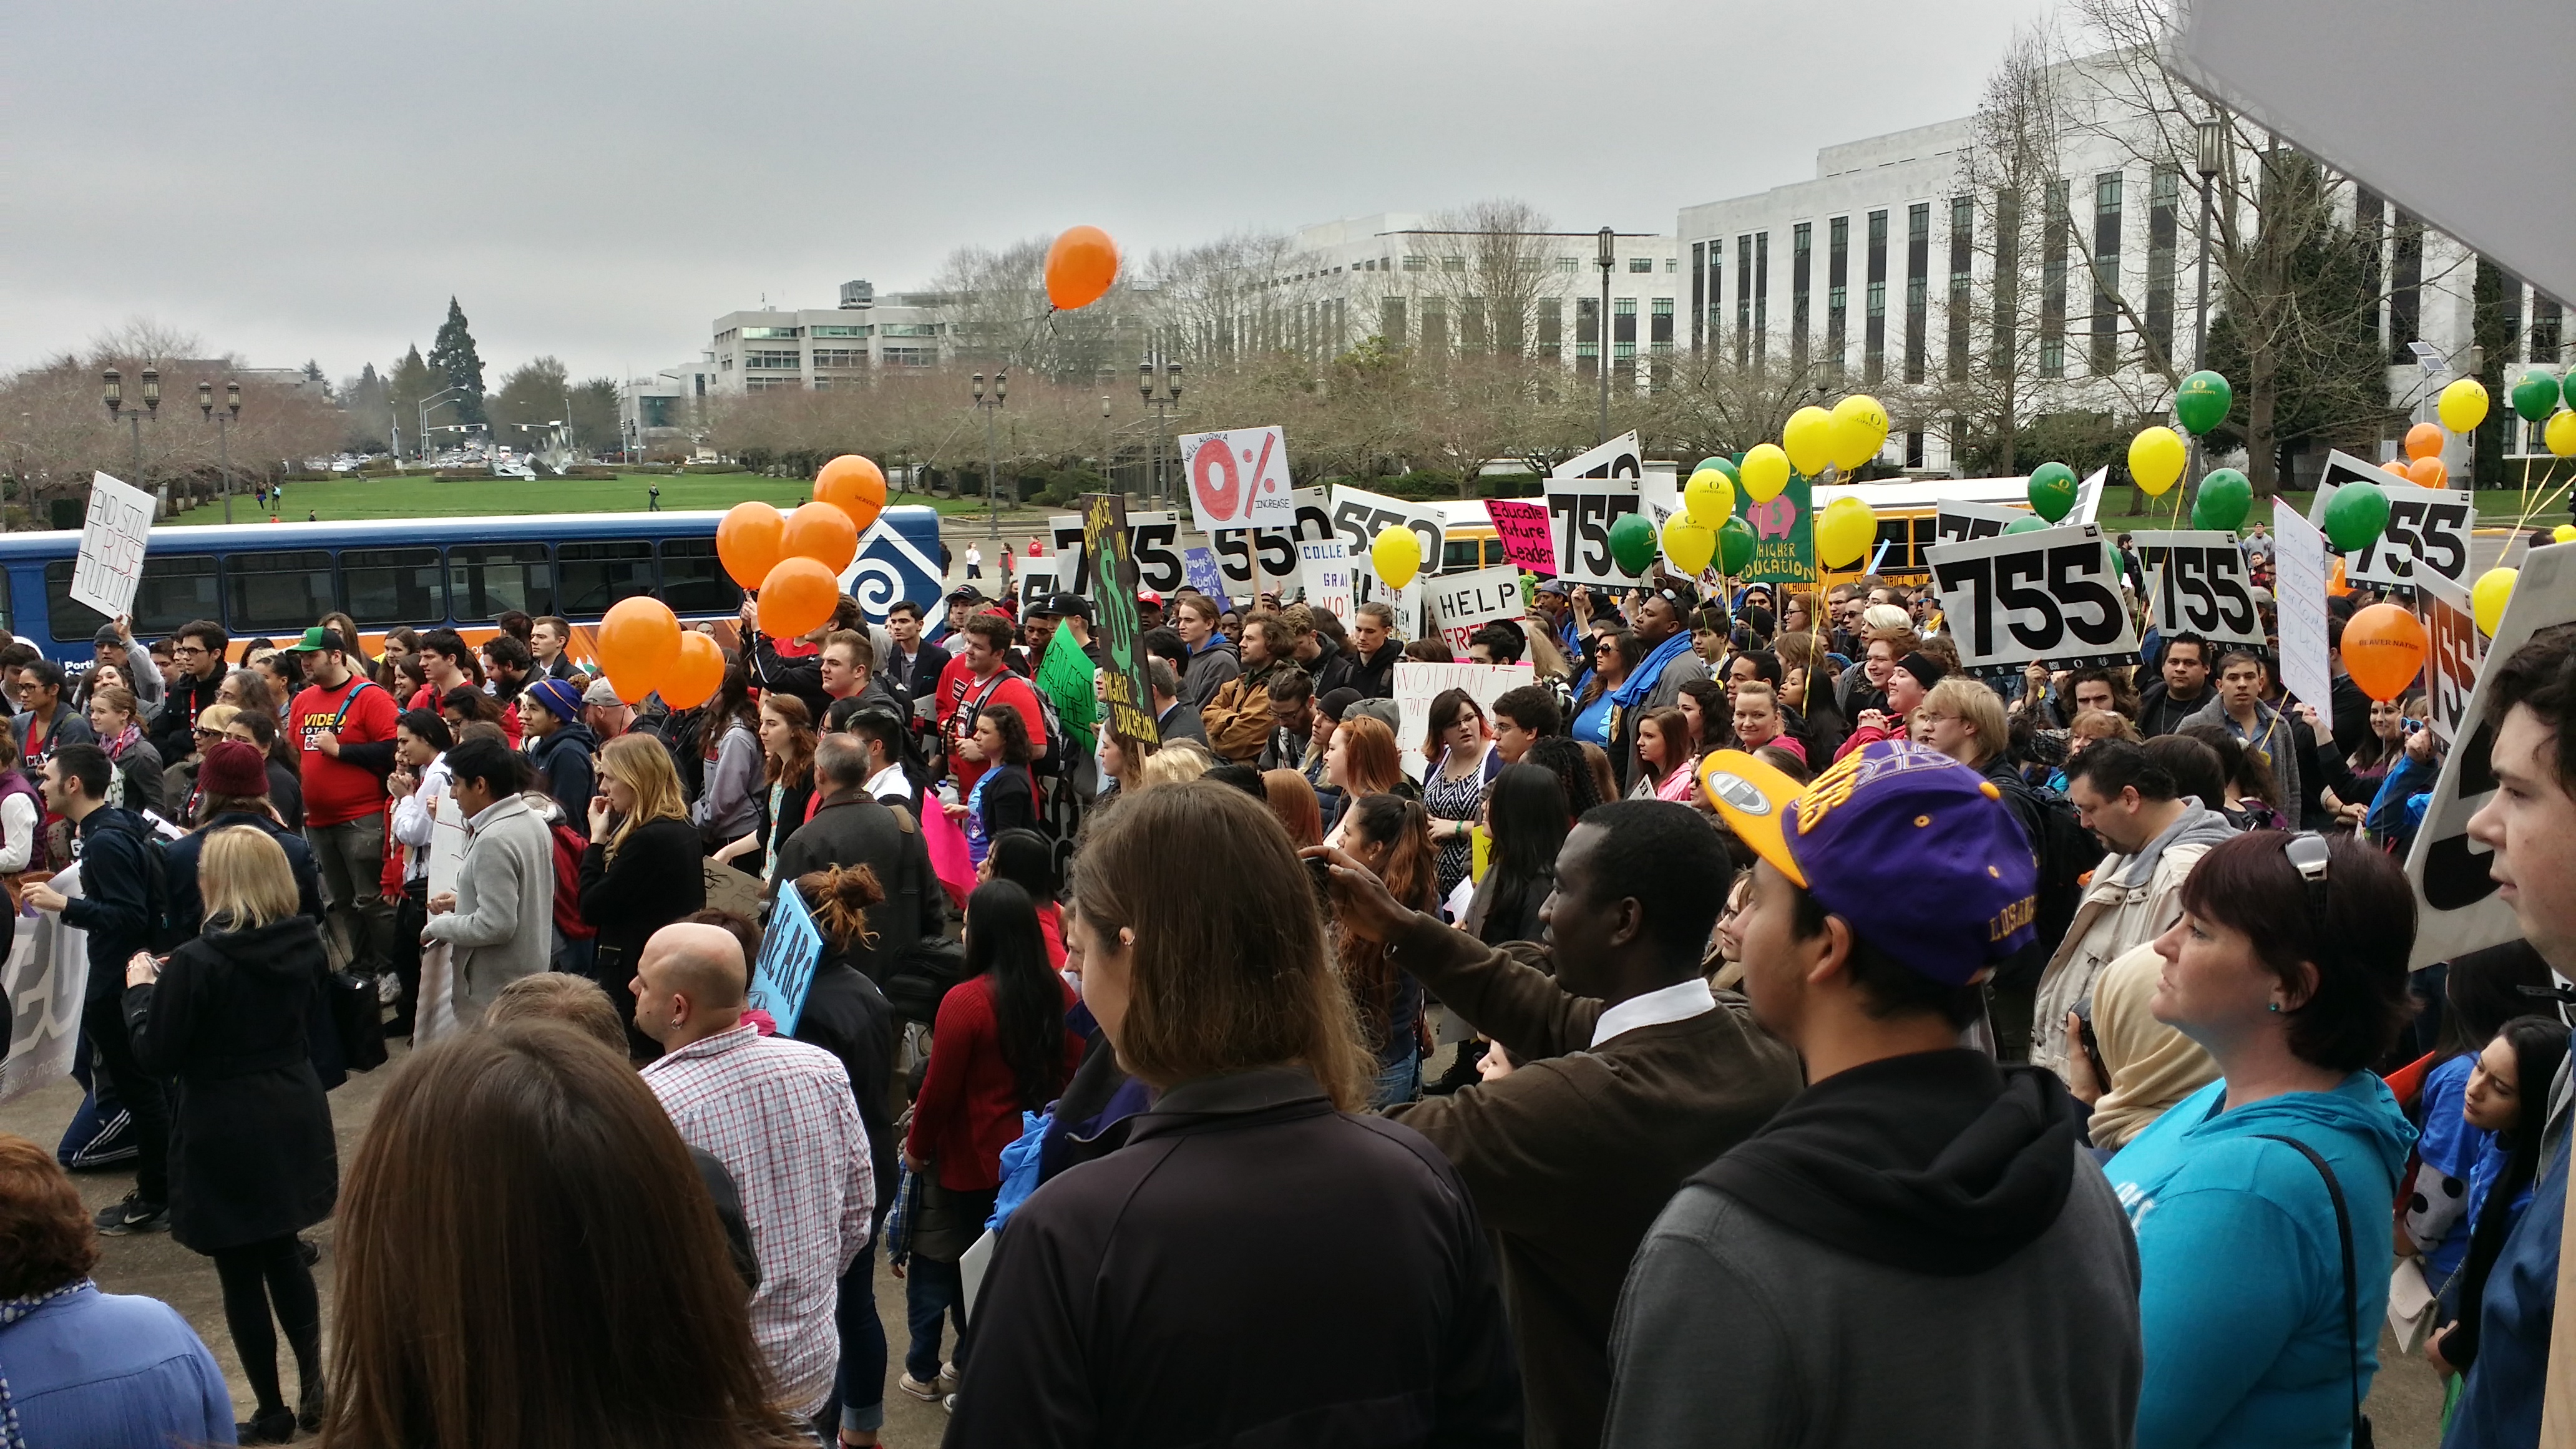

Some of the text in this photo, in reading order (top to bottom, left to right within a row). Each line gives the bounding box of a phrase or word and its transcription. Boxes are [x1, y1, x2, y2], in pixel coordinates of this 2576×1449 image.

[2192, 380, 2206, 389] O
[1184, 446, 1199, 463] WE'LL
[1199, 432, 1221, 445] ALLOW
[1193, 431, 1276, 522] 0%
[1255, 499, 1290, 509] INCREASE
[1488, 500, 1544, 519] Educate
[1497, 520, 1545, 539] Future
[100, 529, 142, 580] RISE
[1055, 524, 1183, 595] 75
[1115, 531, 1128, 562] IN
[1304, 544, 1345, 559] COLLE
[1759, 542, 1796, 558] HIGHER
[1739, 559, 1817, 582] EDUCATION
[1439, 583, 1515, 619] HELP
[1934, 542, 2124, 657] 755
[2137, 547, 2255, 635] 755
[2393, 640, 2419, 650] NATION
[64, 660, 94, 670] Portl
[1104, 671, 1131, 705] HIGHER
[300, 726, 344, 734] LOTTEY
[304, 713, 346, 726] VIDEO
[1115, 703, 1159, 744] EDUCATION
[759, 896, 812, 1017] WE ARE
